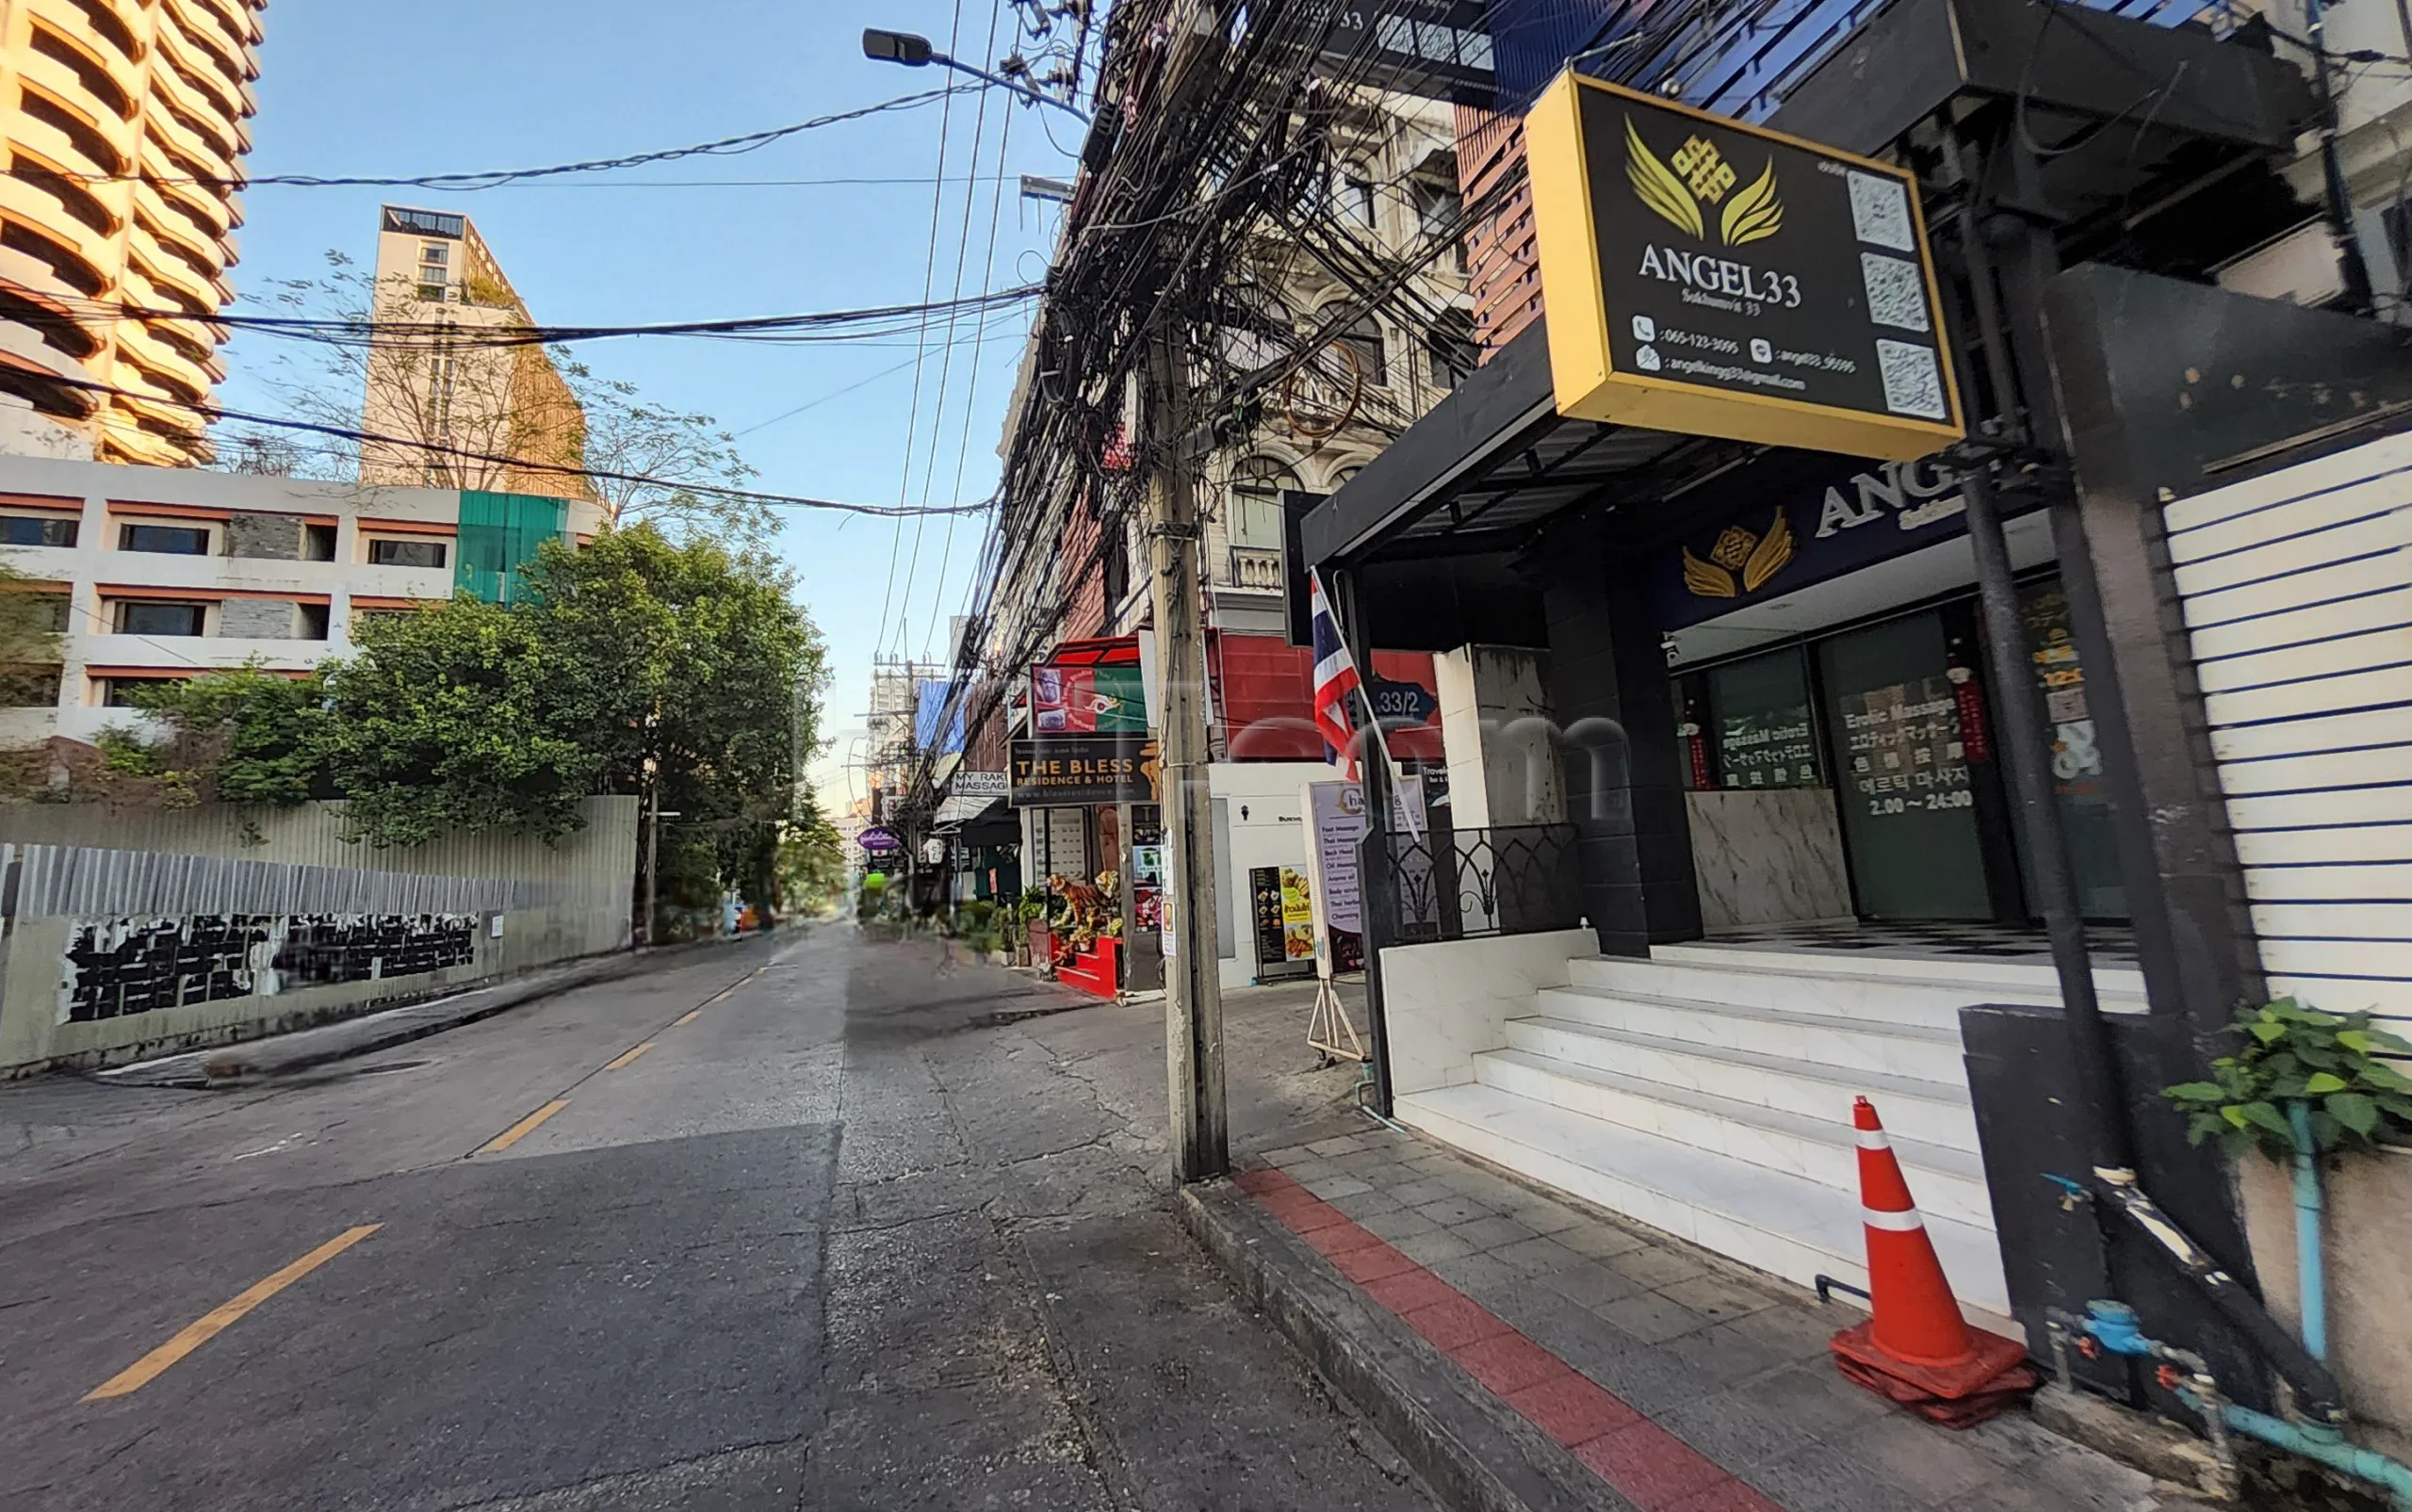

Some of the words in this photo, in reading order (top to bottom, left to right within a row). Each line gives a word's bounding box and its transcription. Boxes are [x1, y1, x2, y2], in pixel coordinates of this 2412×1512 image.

[1638, 243, 1802, 308] ANGEL33
[1815, 461, 1960, 539] ANG
[1016, 759, 1062, 776] THE
[1069, 757, 1133, 774] BLESS
[955, 772, 973, 781] MY
[980, 772, 1007, 781] RAK
[1017, 775, 1081, 787] RESIDENCE
[1084, 775, 1092, 784] &
[1097, 774, 1133, 784] HOTEL
[954, 781, 1007, 790] MASSAG
